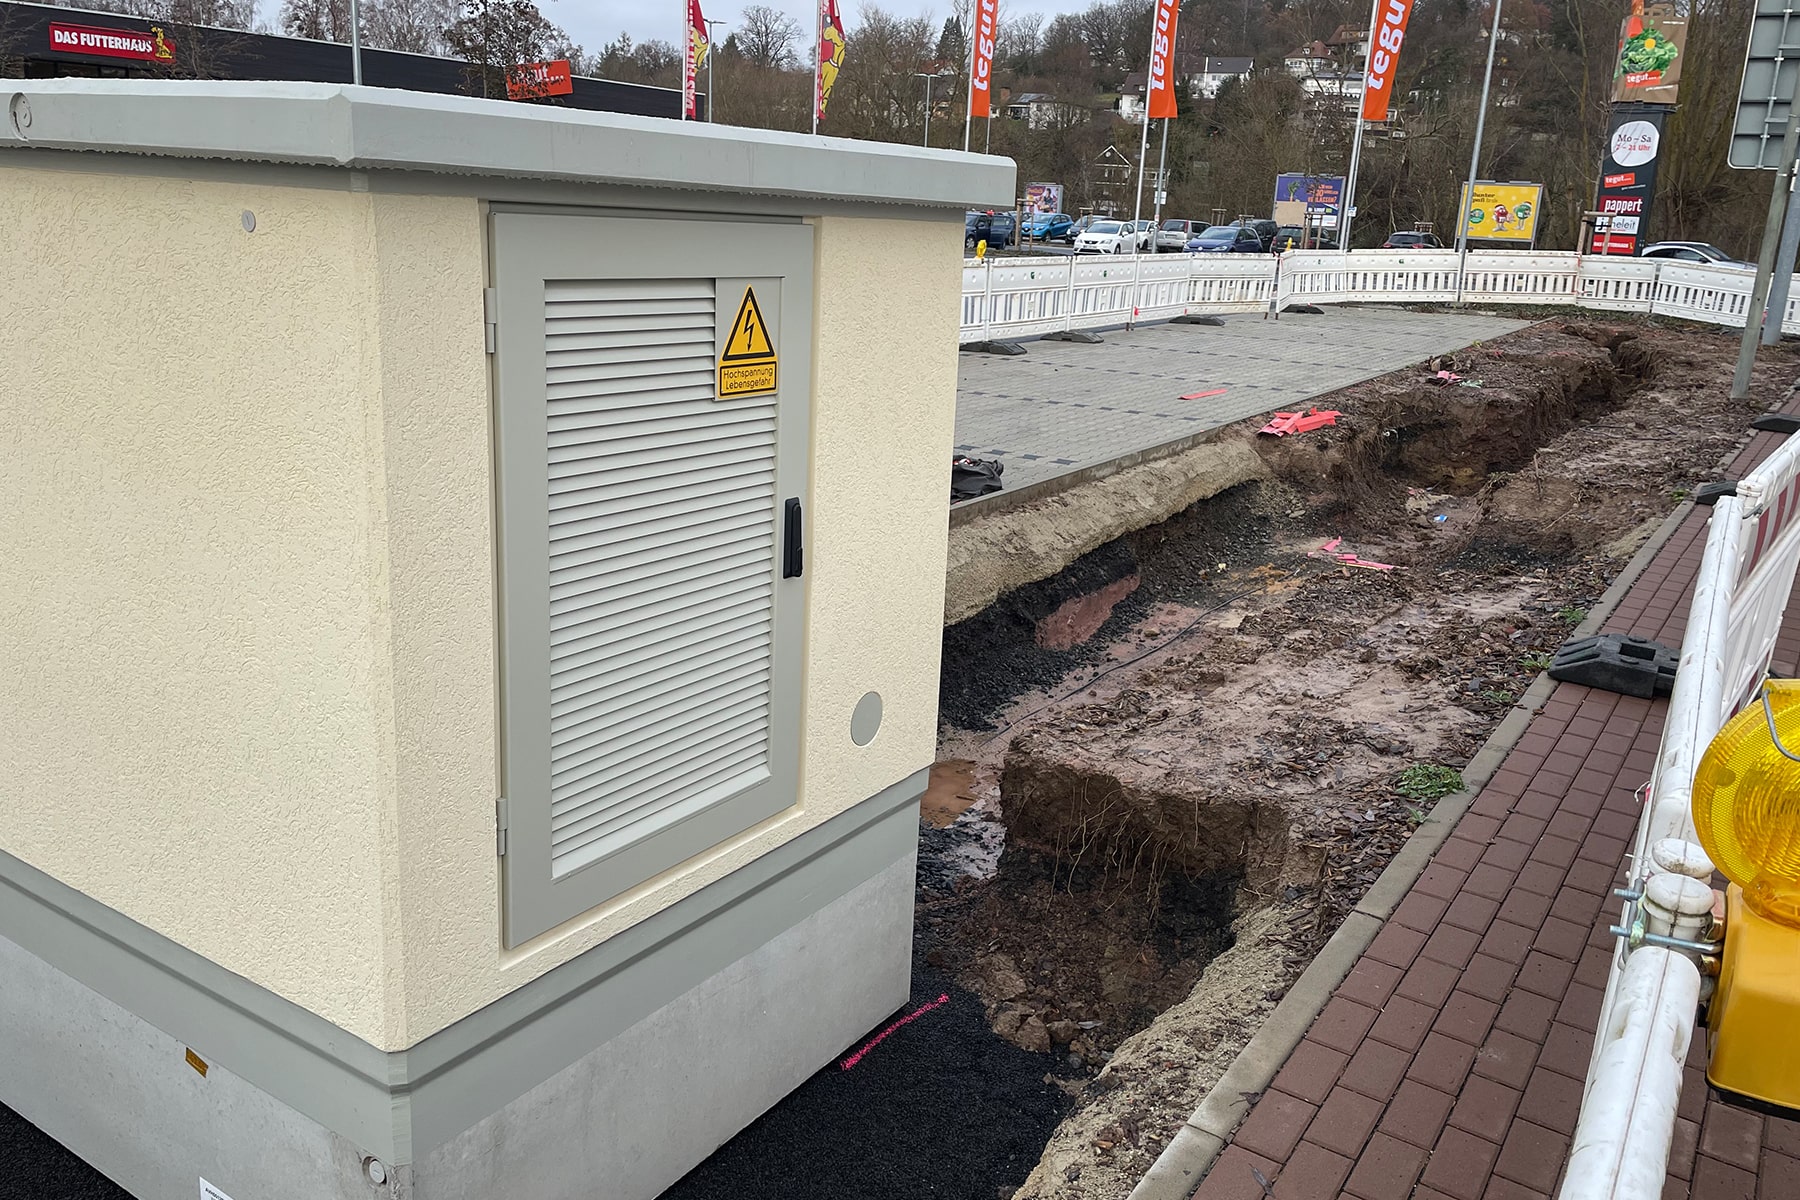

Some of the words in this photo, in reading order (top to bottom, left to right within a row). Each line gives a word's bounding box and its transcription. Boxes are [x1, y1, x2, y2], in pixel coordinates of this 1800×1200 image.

[54, 30, 79, 45] DAS
[80, 33, 153, 53] FUTTERHAUS
[1617, 134, 1632, 143] Mo
[1640, 134, 1652, 143] Sa
[1604, 199, 1643, 214] pappert
[724, 368, 773, 379] Hochspannung
[726, 377, 771, 389] Lebensgefahr
